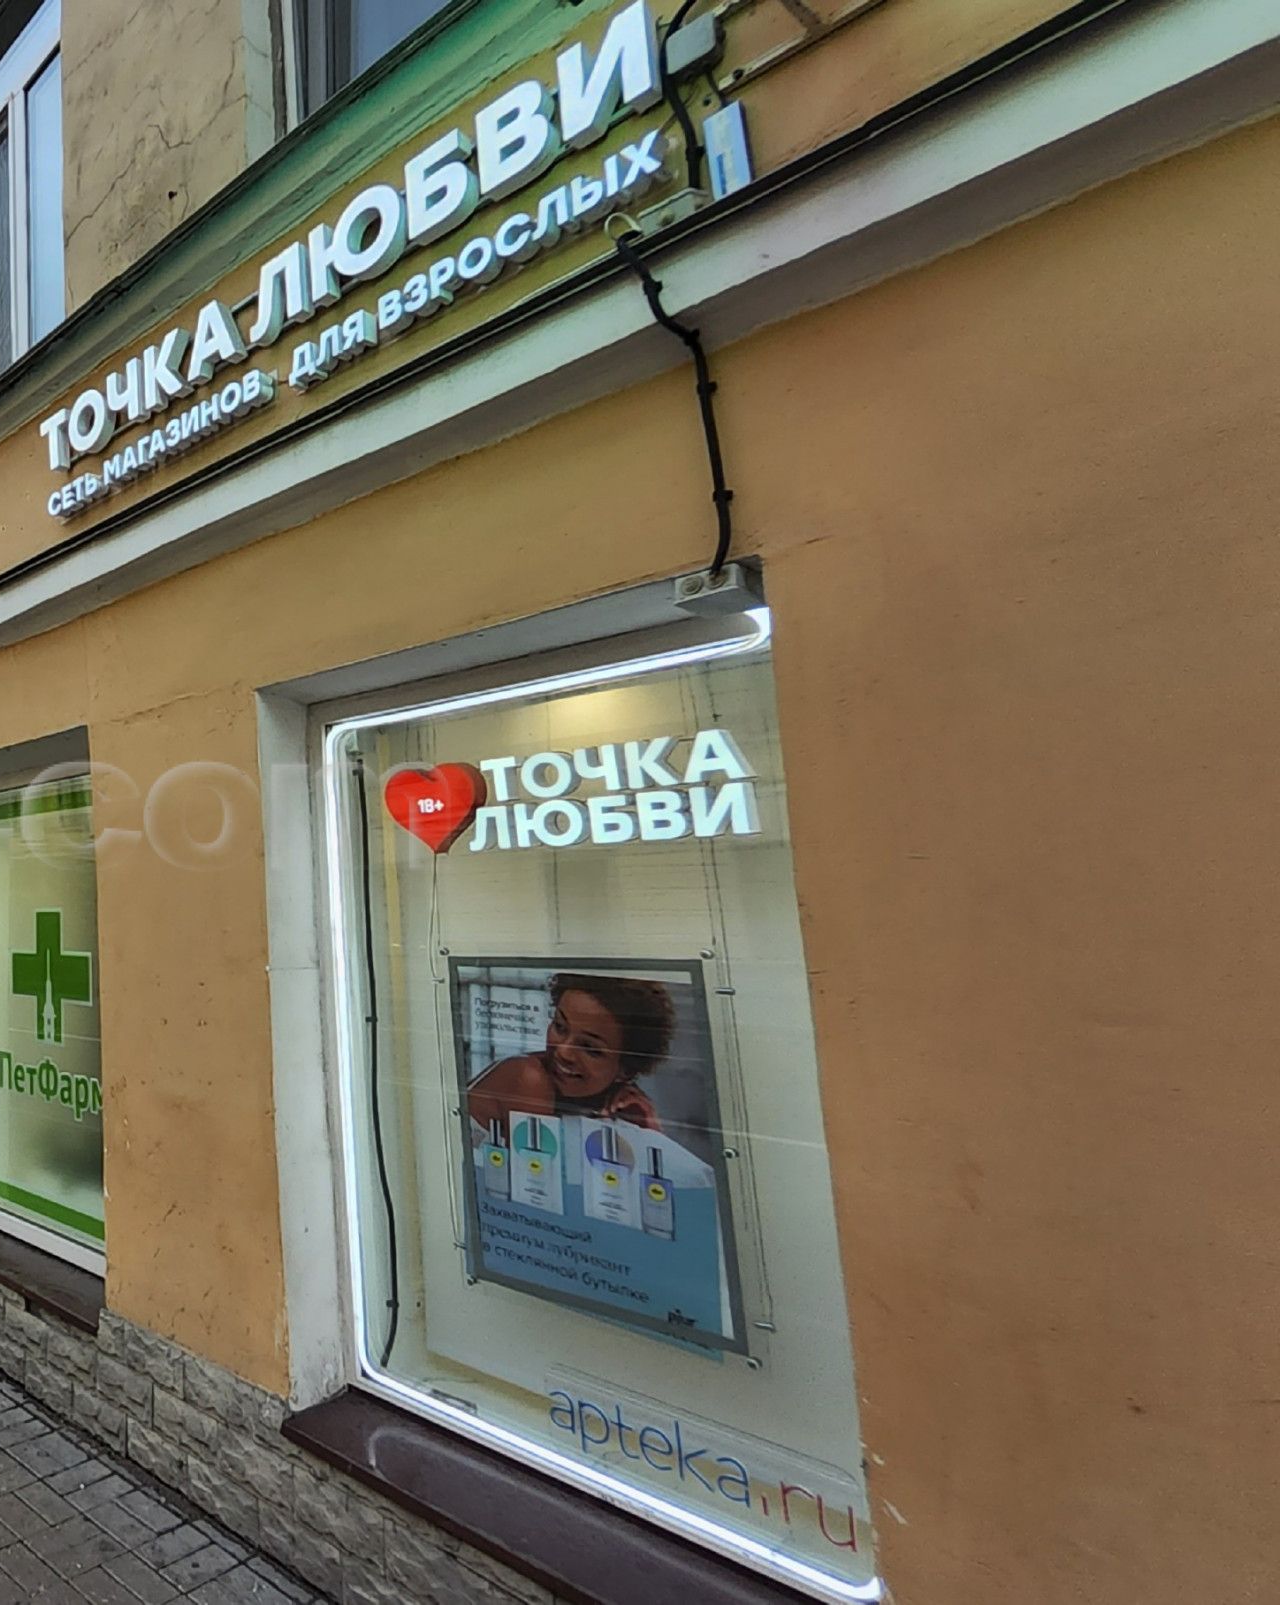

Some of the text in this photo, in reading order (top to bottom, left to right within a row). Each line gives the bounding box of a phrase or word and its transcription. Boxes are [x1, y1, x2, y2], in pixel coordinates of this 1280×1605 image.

[39, 0, 664, 472] ТОЧКА ЛЮБВИ
[47, 128, 665, 519] СЕТЬ МАГАЗИНОВ ДЛЯ ВЗРОСЛЫХ
[479, 729, 756, 801] ТОЧКА
[417, 798, 445, 814] 18+
[469, 782, 760, 852] ЛЮБВИ
[481, 1202, 593, 1242] Захватывающий
[494, 1244, 578, 1281] стеклянной
[581, 1270, 650, 1304] бутылке
[548, 1391, 857, 1552] apteka.ru
